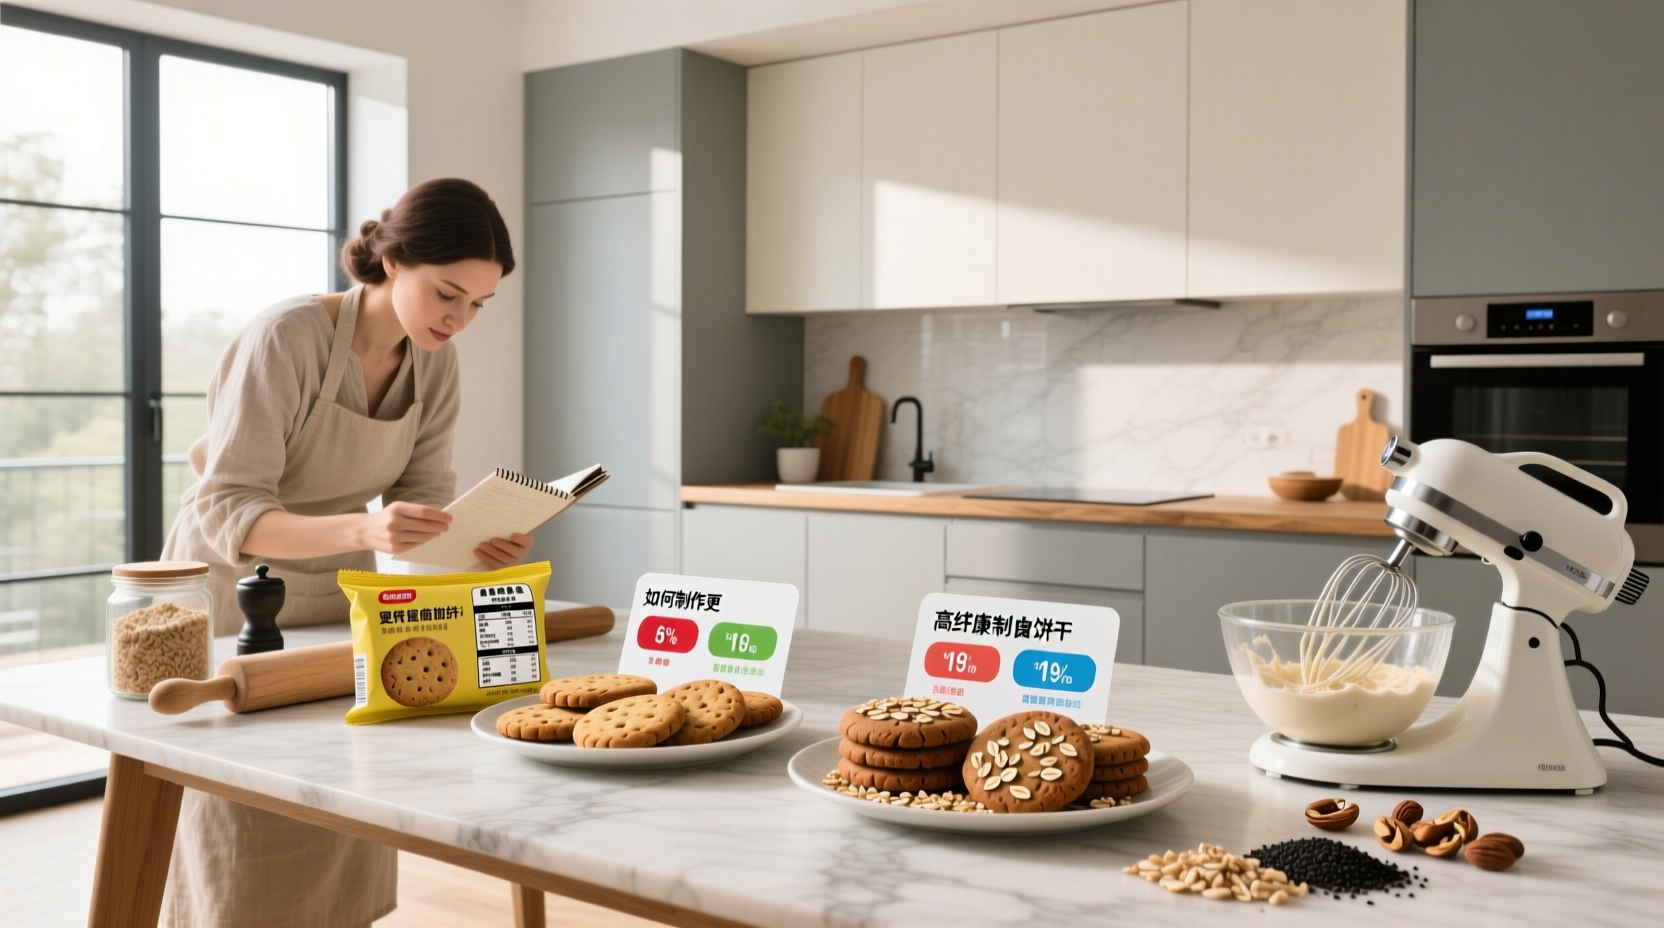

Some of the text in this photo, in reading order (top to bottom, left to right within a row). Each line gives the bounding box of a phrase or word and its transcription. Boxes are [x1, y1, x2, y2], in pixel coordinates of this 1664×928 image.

[643, 588, 722, 612] 如何制作更
[655, 625, 678, 645] 6%
